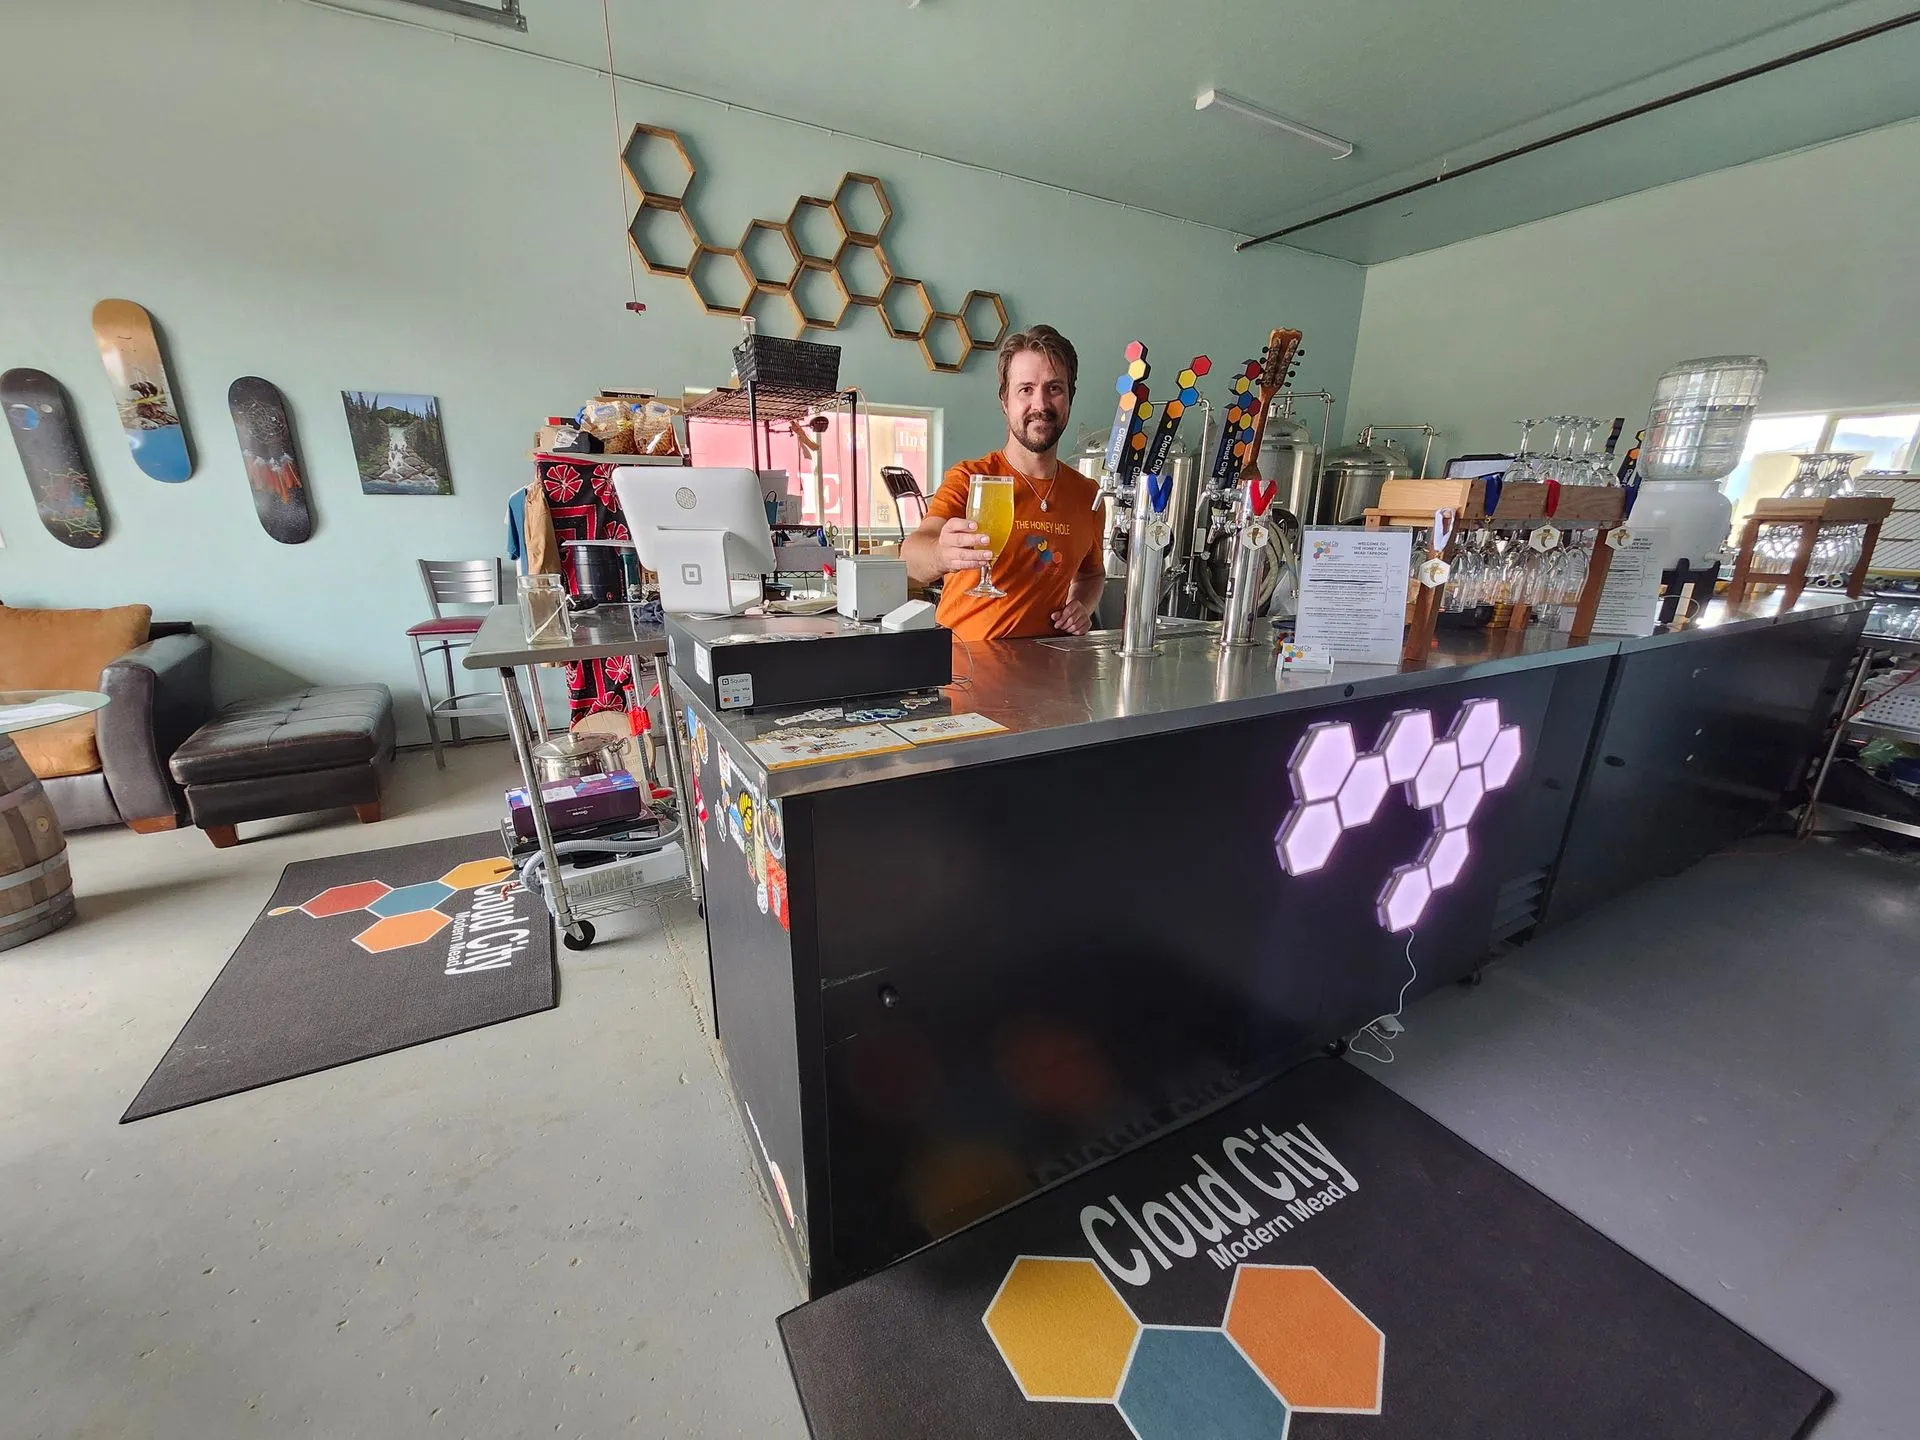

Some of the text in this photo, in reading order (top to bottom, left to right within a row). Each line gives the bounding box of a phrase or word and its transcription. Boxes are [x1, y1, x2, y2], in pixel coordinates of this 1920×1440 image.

[1107, 428, 1126, 470] Cloud City
[1150, 434, 1172, 474] Cloud City
[1217, 438, 1235, 476] Cloud City
[1130, 466, 1141, 488] Clou
[1231, 471, 1240, 489] Clou
[1015, 520, 1071, 535] THE HONEY HOLE
[444, 928, 530, 975] City
[446, 910, 471, 968] Modern Mead
[1079, 1121, 1360, 1287] Cloud City
[1206, 1179, 1347, 1271] Modern Mead
